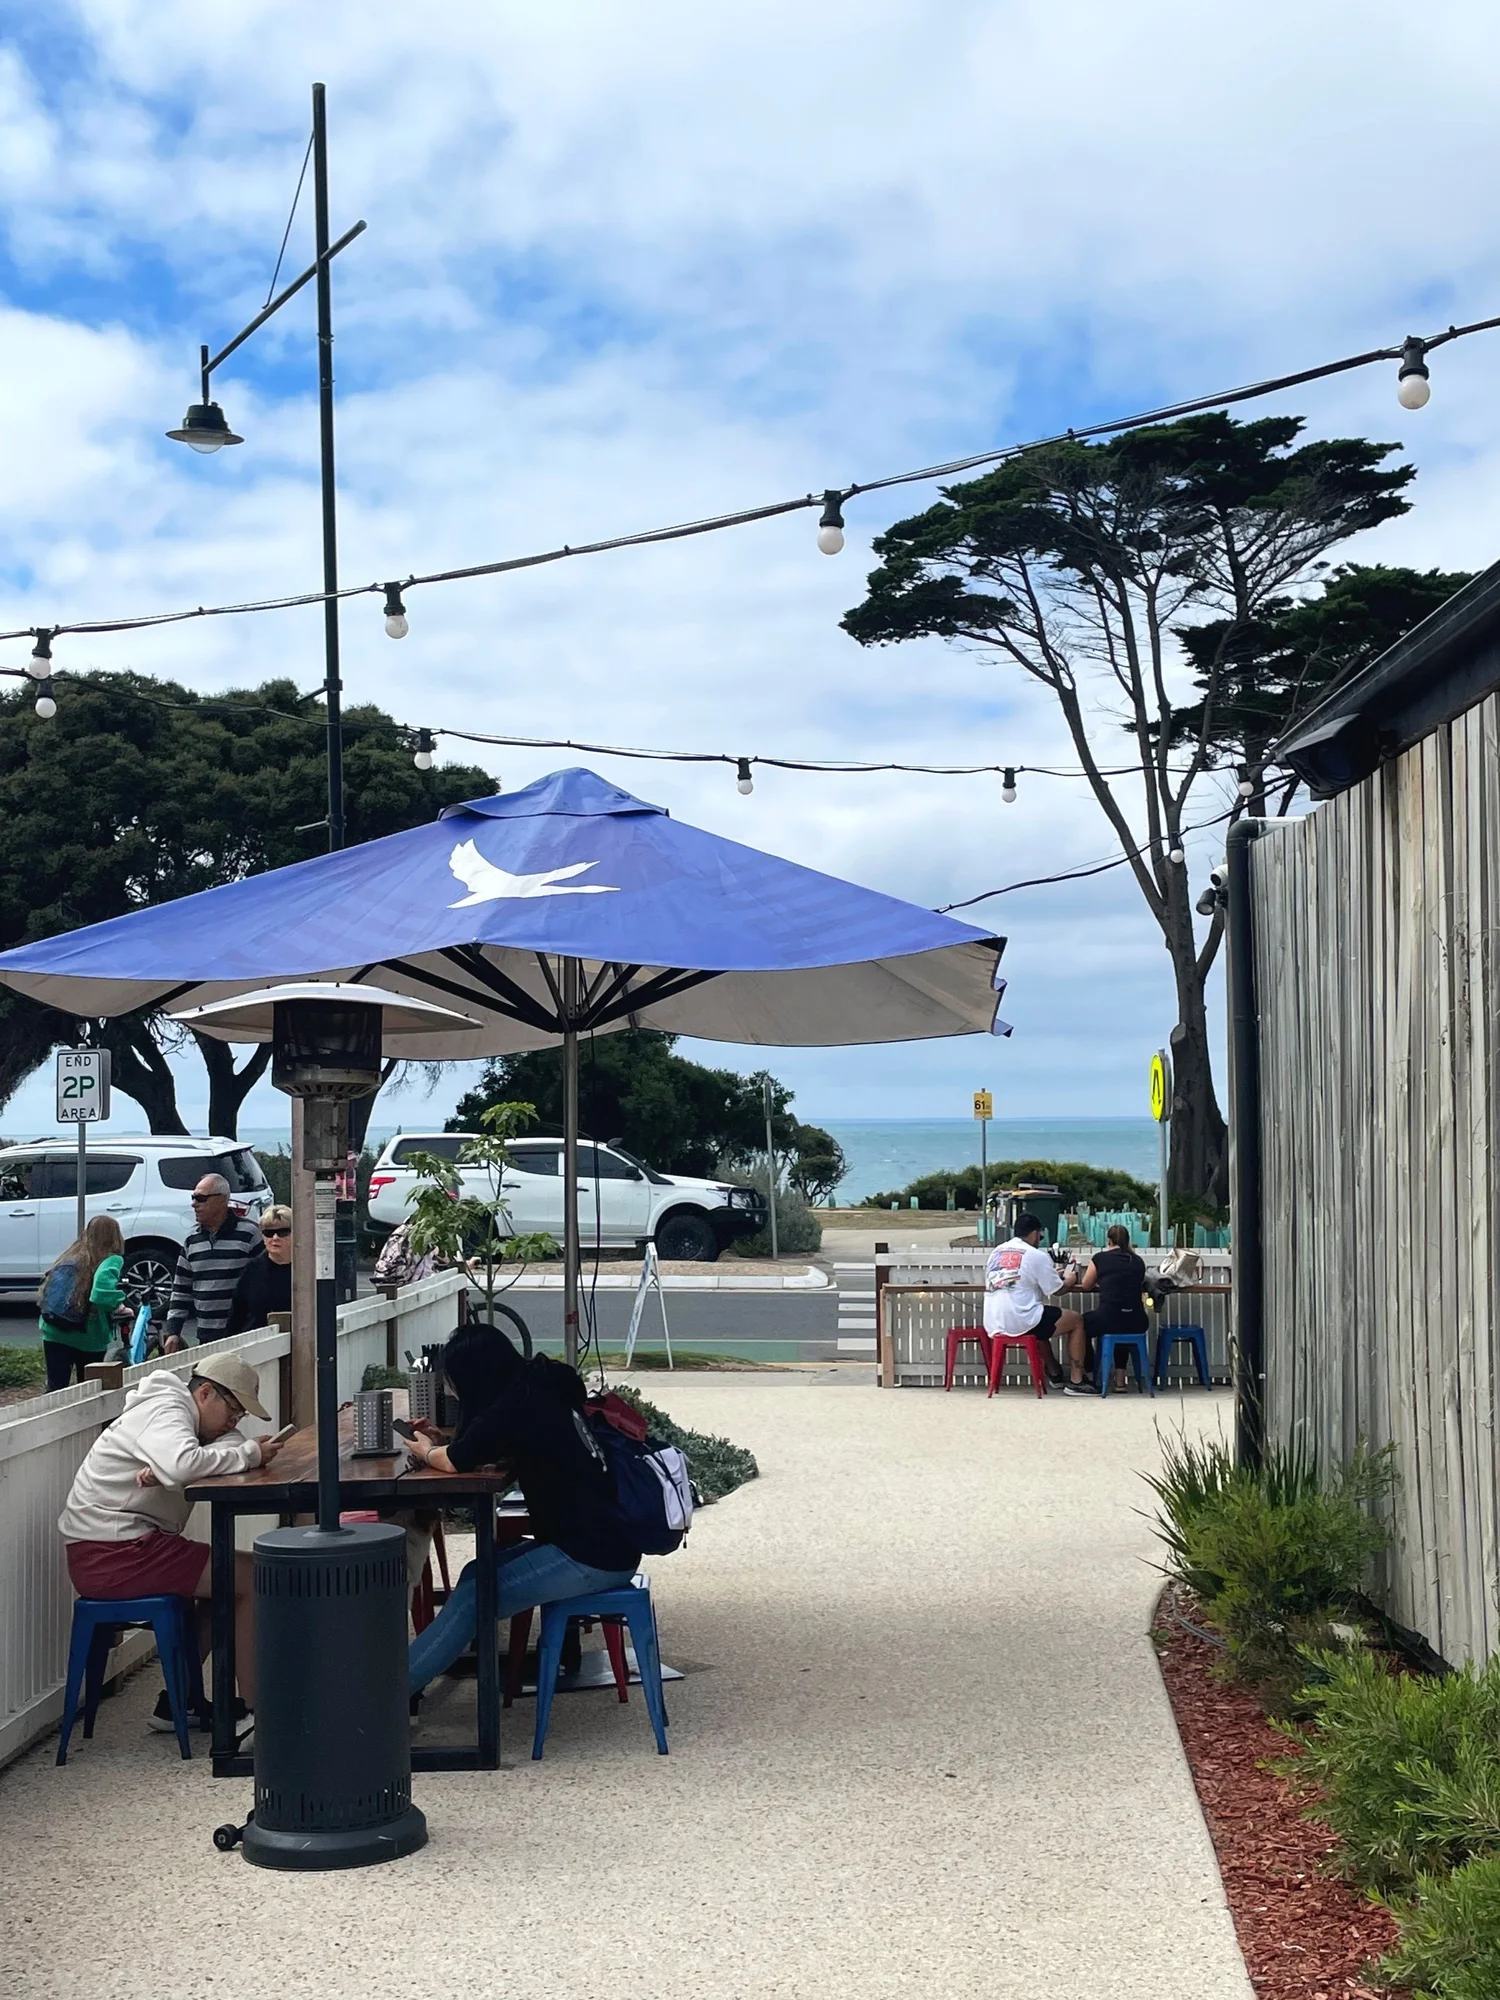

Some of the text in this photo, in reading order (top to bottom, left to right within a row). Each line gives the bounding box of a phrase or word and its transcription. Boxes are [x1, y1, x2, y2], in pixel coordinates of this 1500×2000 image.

[65, 1056, 91, 1067] END
[63, 1076, 95, 1098] 2P
[974, 1100, 985, 1110] 61
[61, 1108, 96, 1119] AREA
